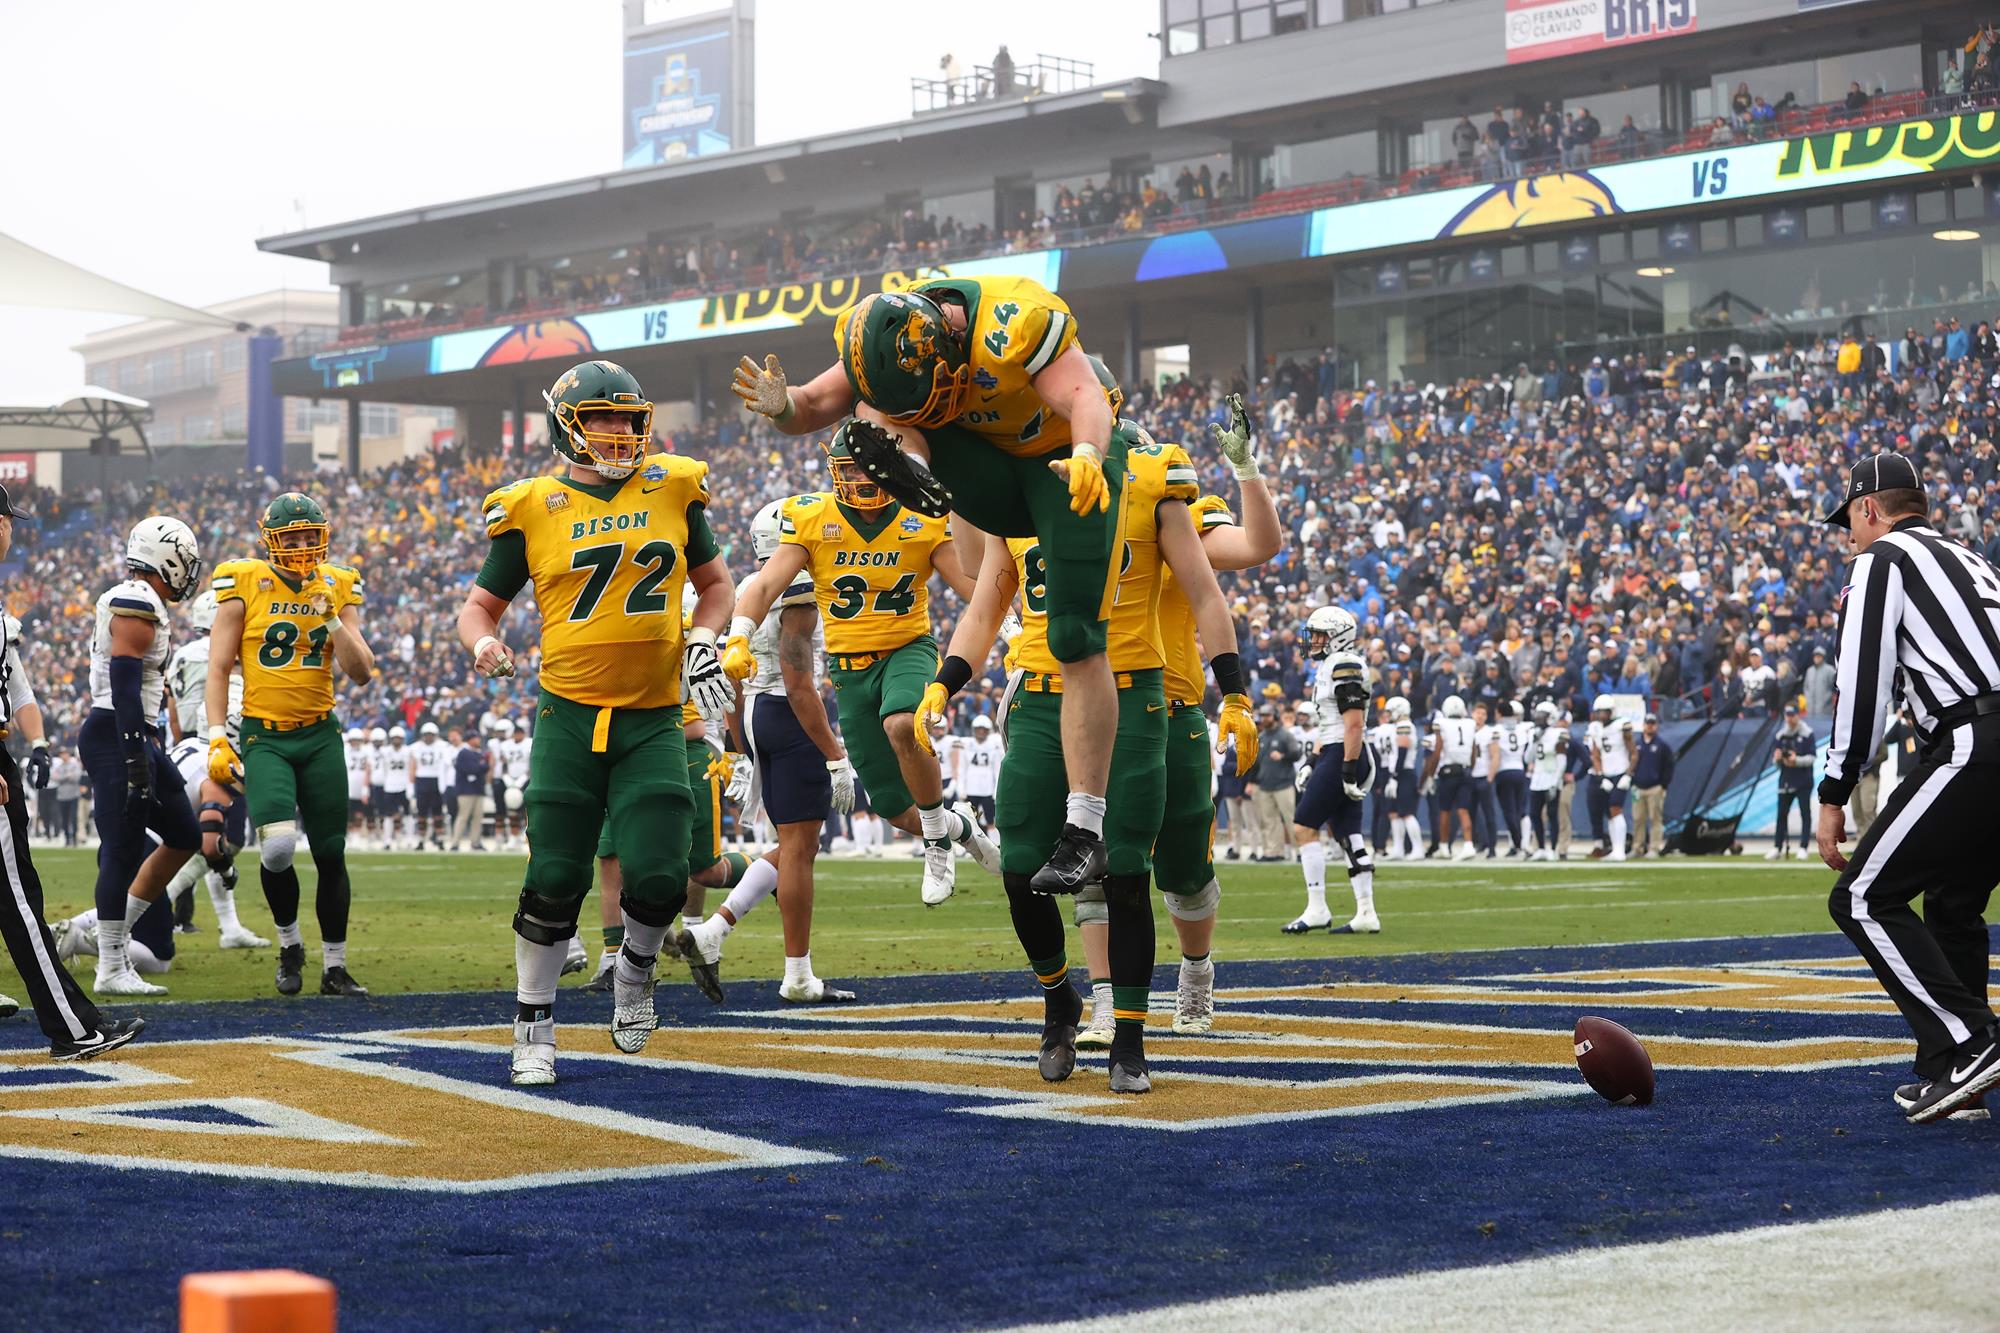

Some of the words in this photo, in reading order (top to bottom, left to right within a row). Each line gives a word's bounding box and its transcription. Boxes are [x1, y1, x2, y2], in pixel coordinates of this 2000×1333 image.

[1532, 2, 1598, 23] FERNANDO
[1533, 18, 1582, 38] CLAVIJO
[1692, 157, 1728, 199] VS
[643, 309, 668, 342] VS
[984, 301, 1020, 359] 44
[570, 510, 650, 542] BISON
[833, 551, 901, 567] BISON
[567, 539, 677, 623] 72
[828, 573, 918, 621] 34
[258, 620, 330, 669] 81
[1457, 726, 1465, 746] 1
[1508, 733, 1519, 752] 9
[970, 752, 990, 767] 43
